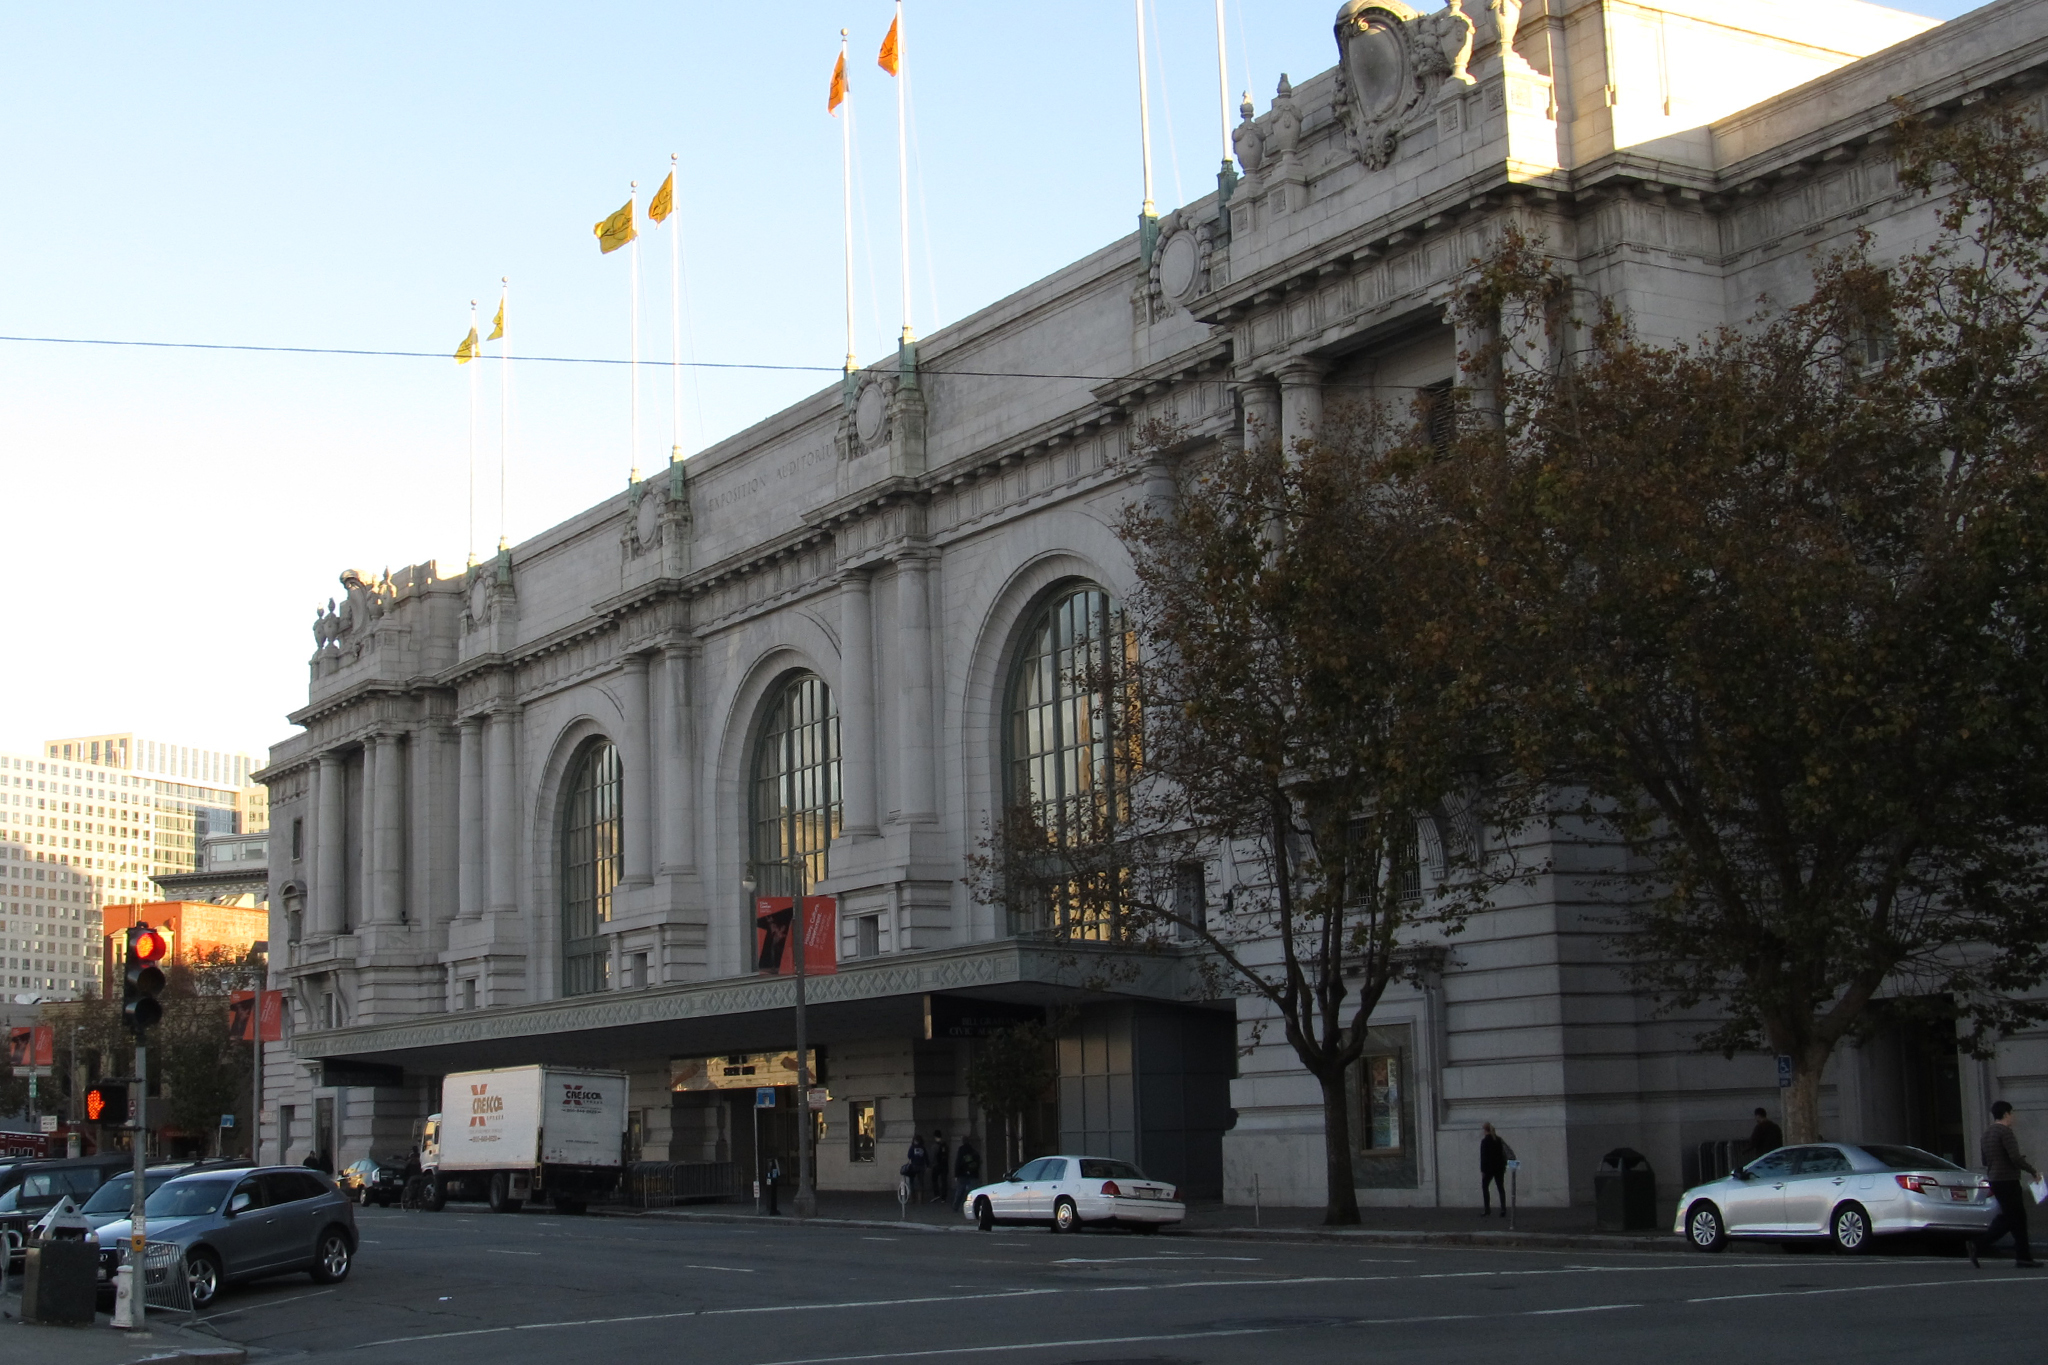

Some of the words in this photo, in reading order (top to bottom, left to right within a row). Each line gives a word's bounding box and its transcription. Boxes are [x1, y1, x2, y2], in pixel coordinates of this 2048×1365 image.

[709, 478, 766, 512] EXPOSITION
[776, 443, 833, 480] AUDITORIU
[950, 1027, 973, 1035] CIVIC
